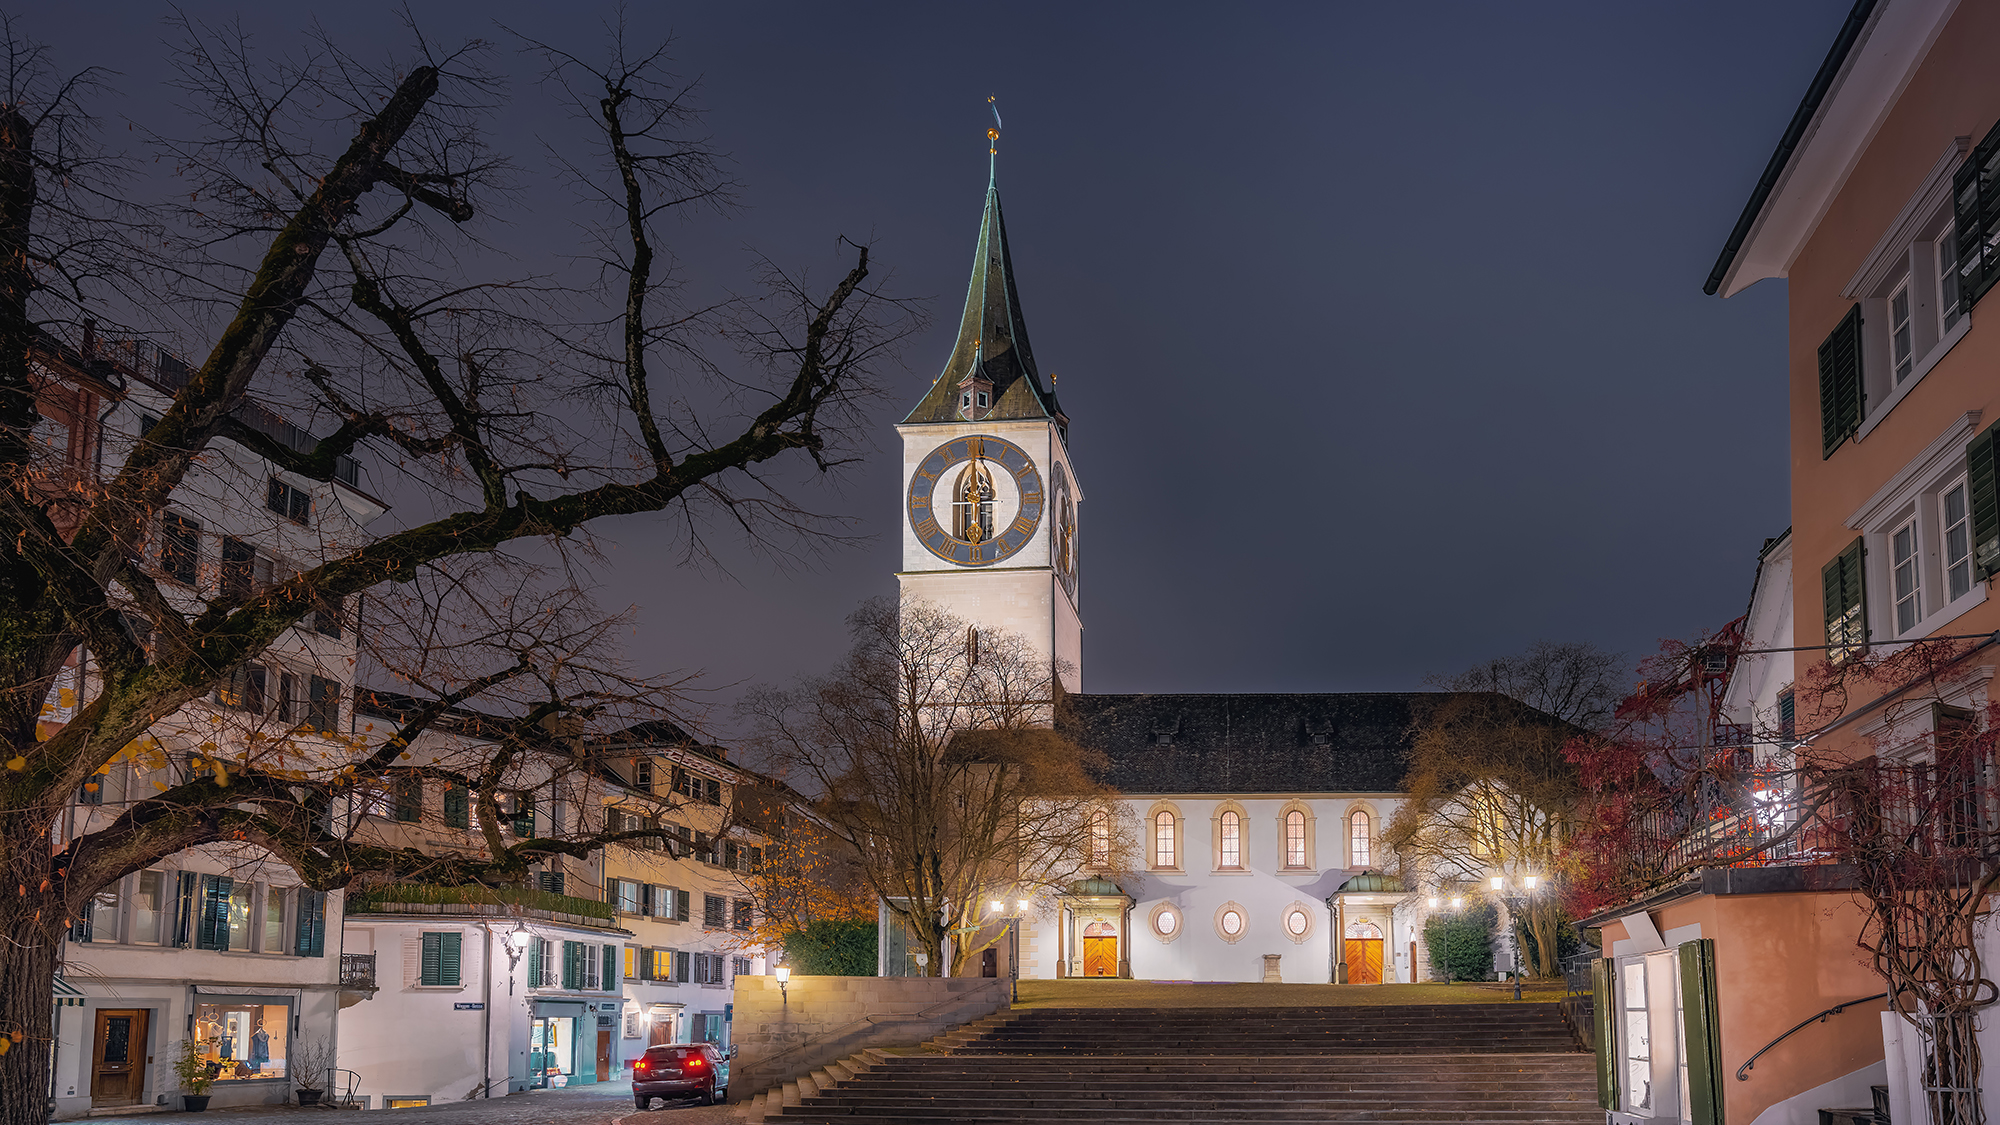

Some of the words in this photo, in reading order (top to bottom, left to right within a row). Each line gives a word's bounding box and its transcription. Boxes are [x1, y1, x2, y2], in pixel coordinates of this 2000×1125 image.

[939, 447, 956, 465] XI
[1000, 446, 1008, 460] I
[920, 468, 936, 481] X
[1017, 464, 1032, 479] II
[913, 495, 928, 509] IX
[1024, 492, 1040, 505] III
[1013, 516, 1035, 536] IIII
[997, 538, 1011, 553] V
[969, 546, 983, 562] VI
